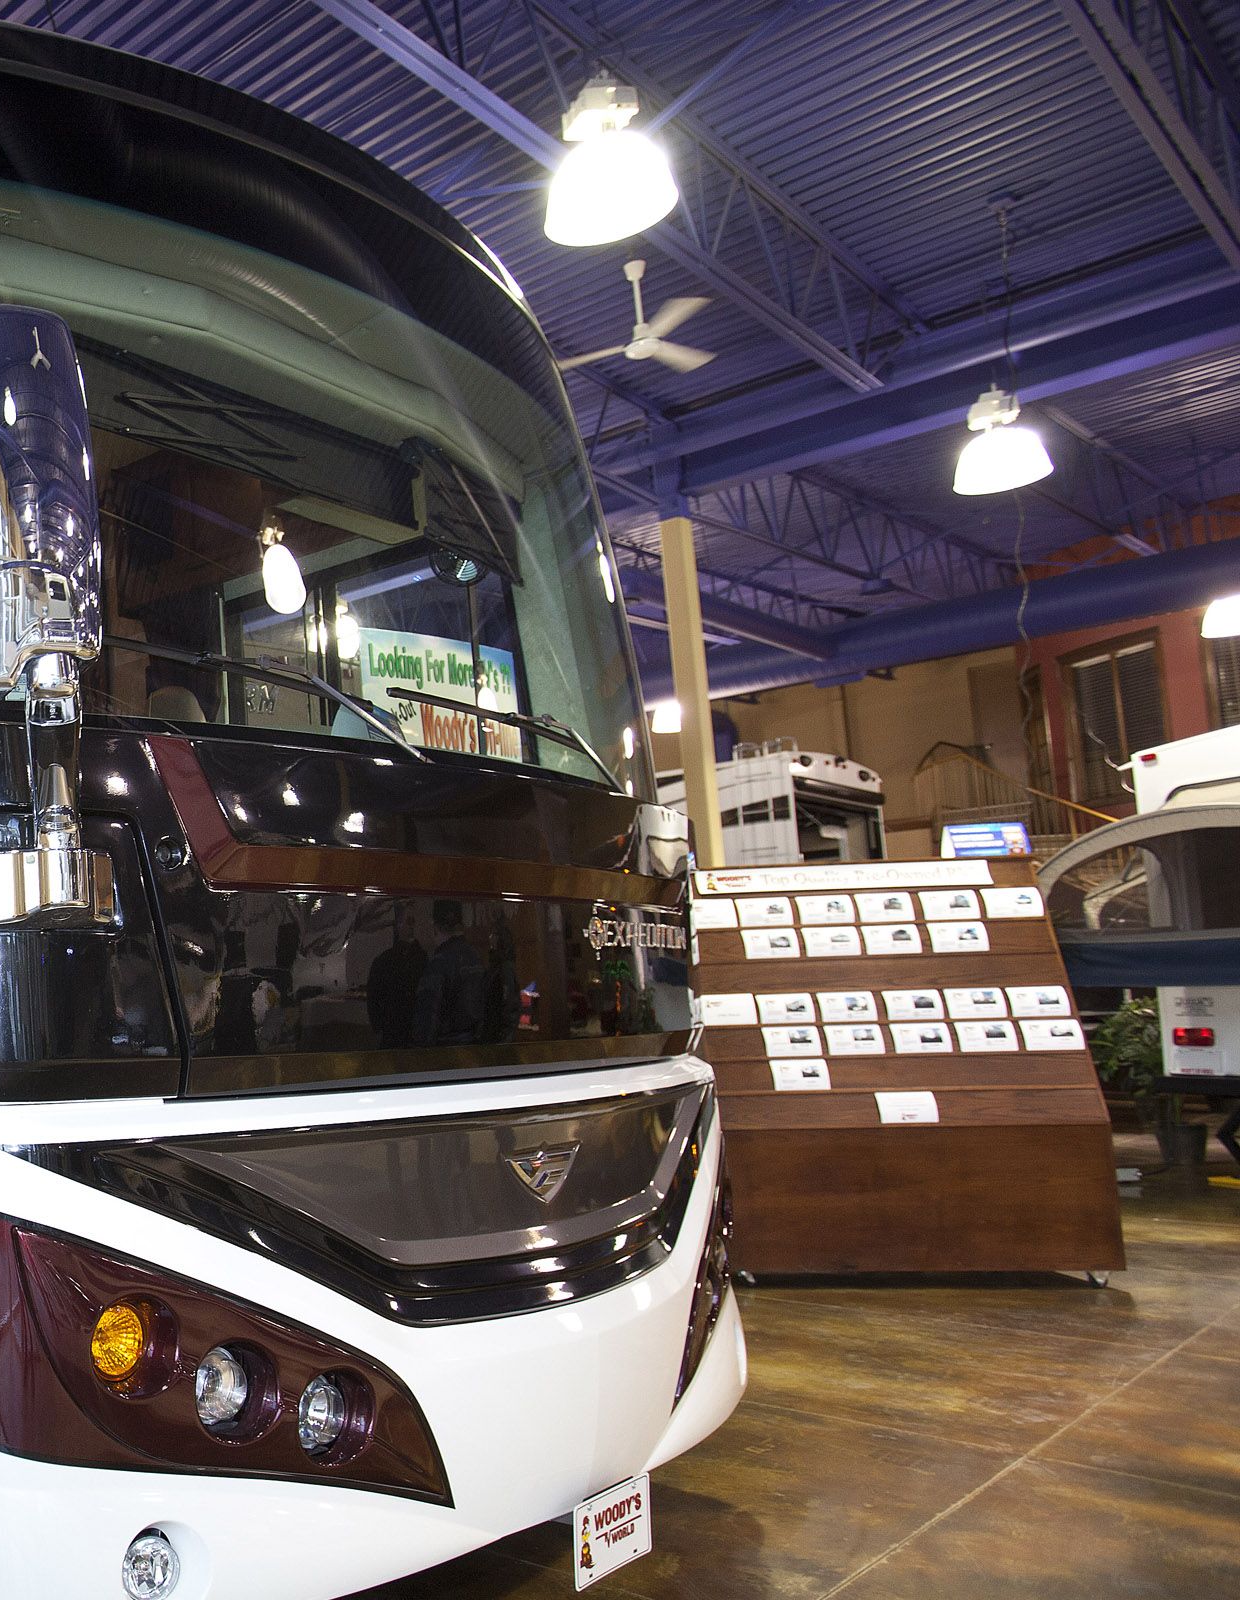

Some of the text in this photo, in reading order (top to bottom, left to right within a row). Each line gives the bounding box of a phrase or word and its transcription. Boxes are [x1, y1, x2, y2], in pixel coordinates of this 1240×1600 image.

[368, 643, 424, 690] Looking
[426, 649, 445, 684] For
[447, 653, 476, 689] More
[420, 702, 477, 753] Woody's
[594, 1492, 642, 1532] WOODY'S
[611, 1522, 635, 1544] WORLD
